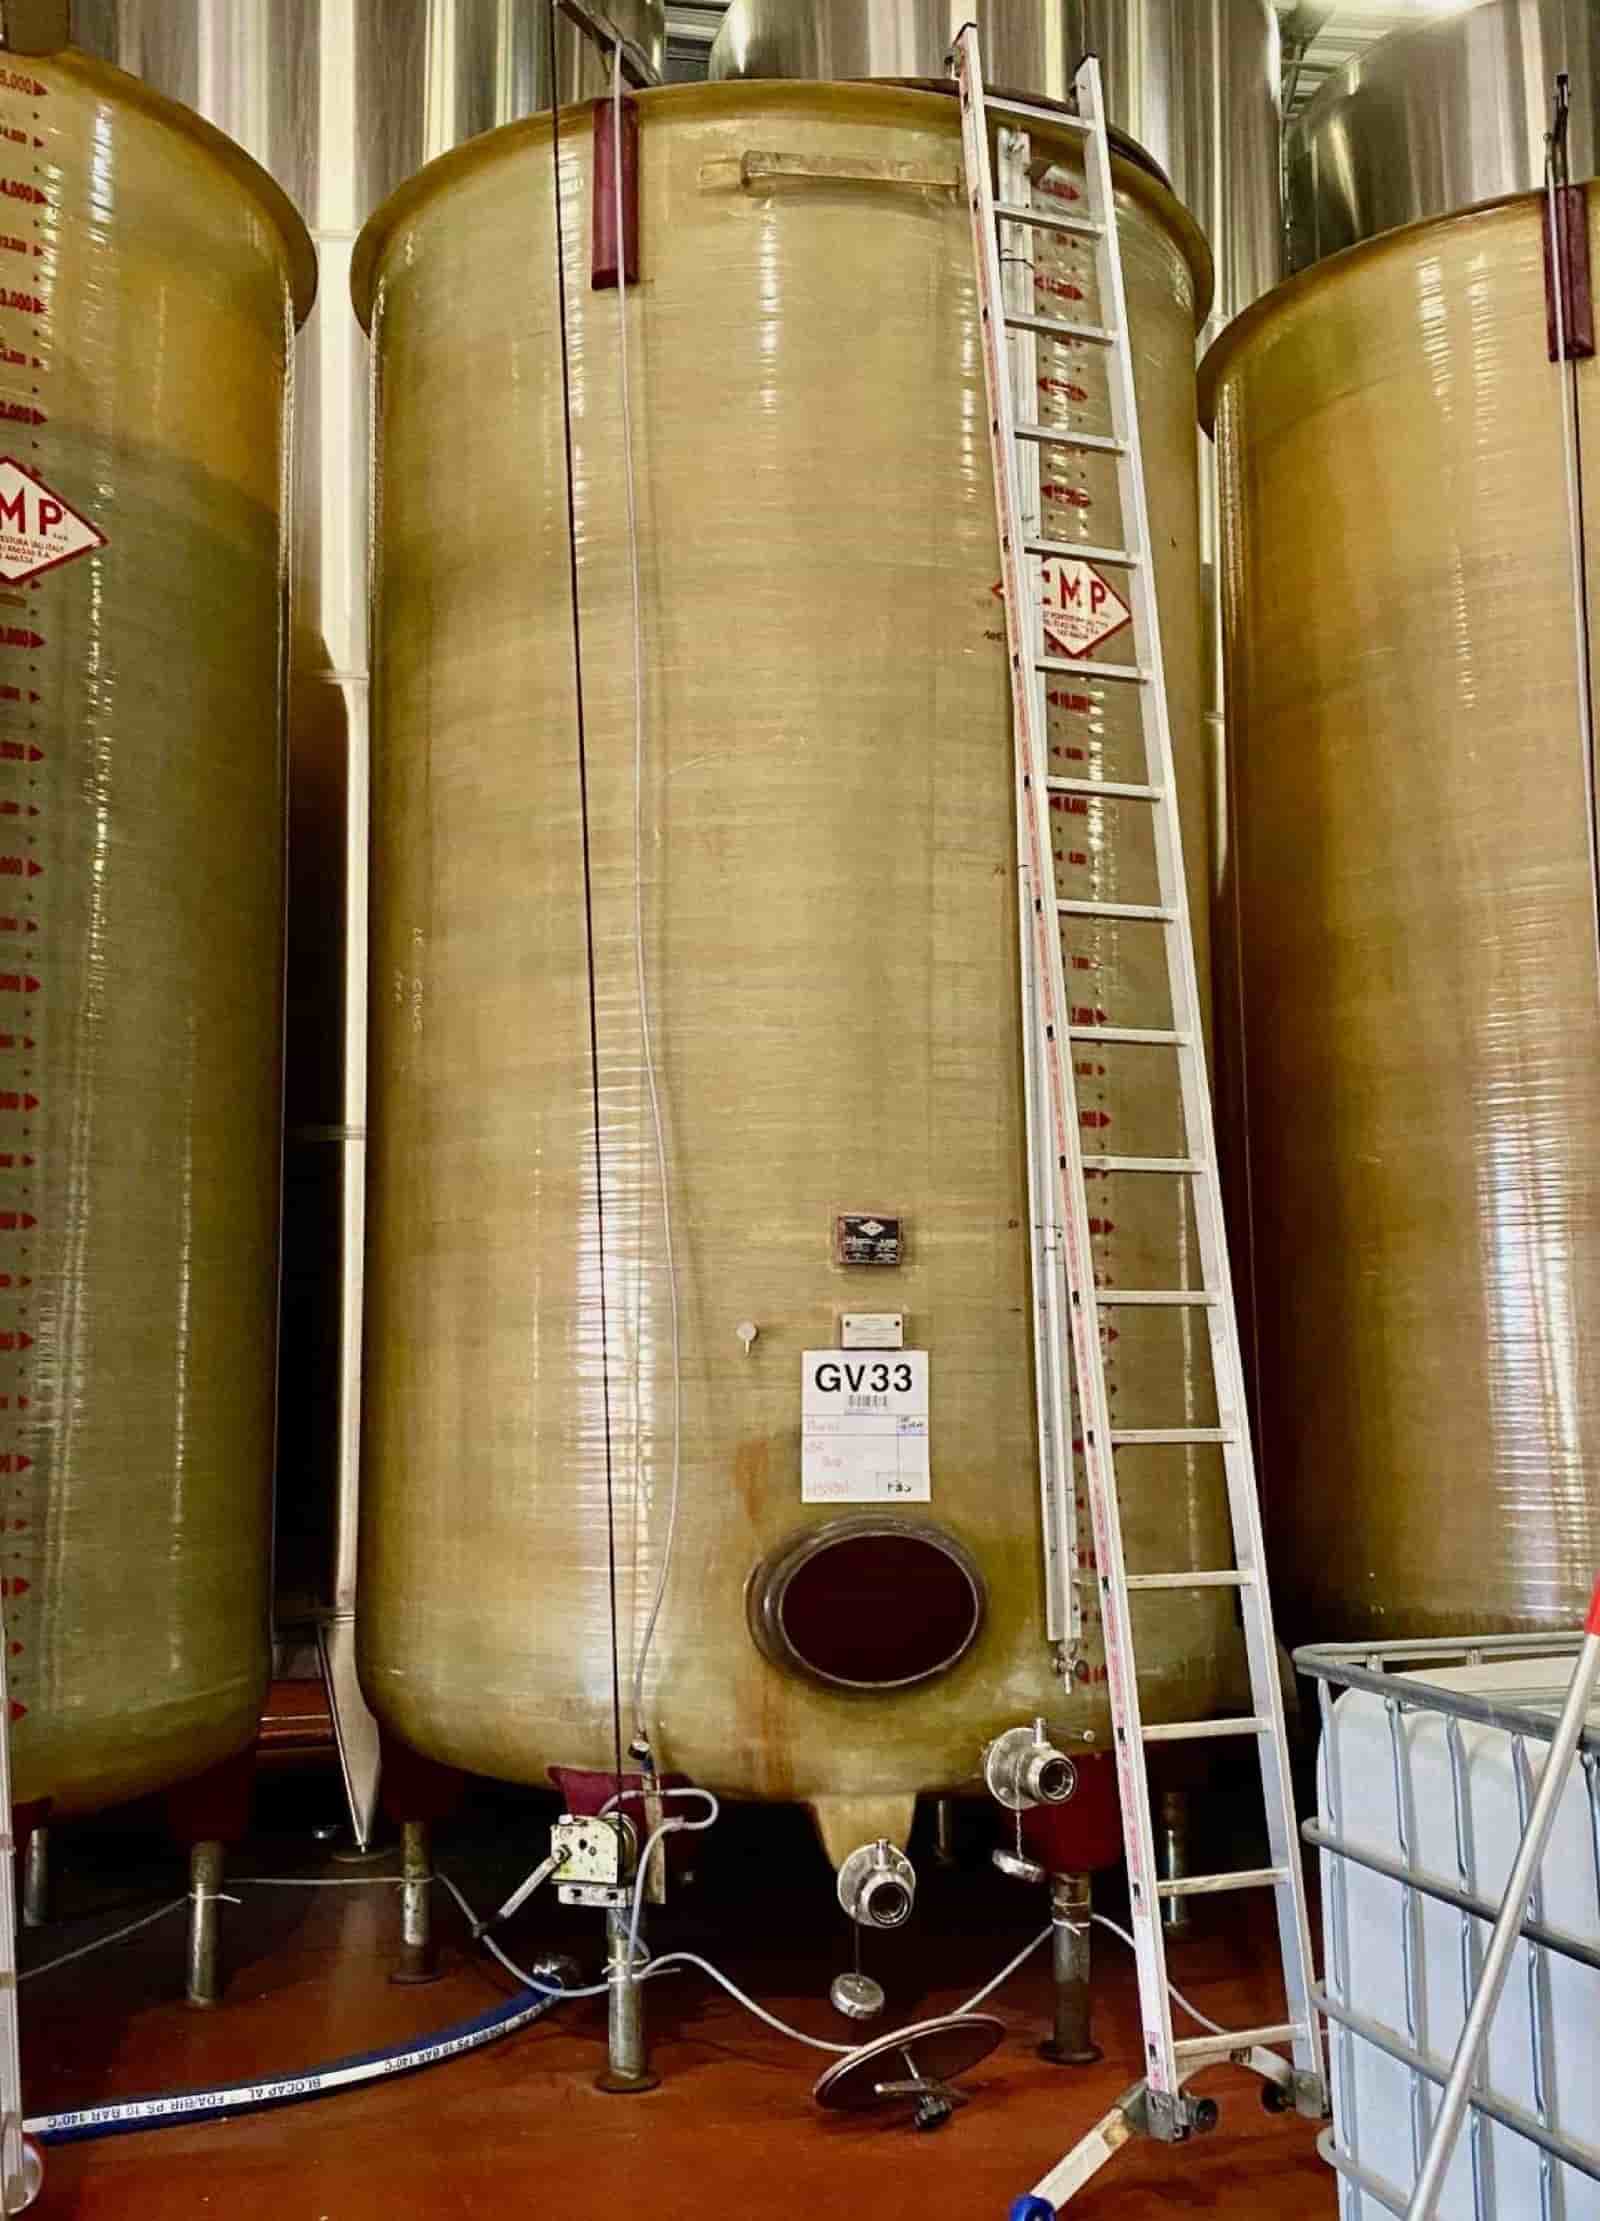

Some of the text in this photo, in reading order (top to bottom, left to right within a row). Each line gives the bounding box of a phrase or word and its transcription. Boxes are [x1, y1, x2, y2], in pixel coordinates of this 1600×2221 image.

[815, 1363, 912, 1393] GV33
[90, 2106, 122, 2123] BAR
[145, 2100, 166, 2115] PS
